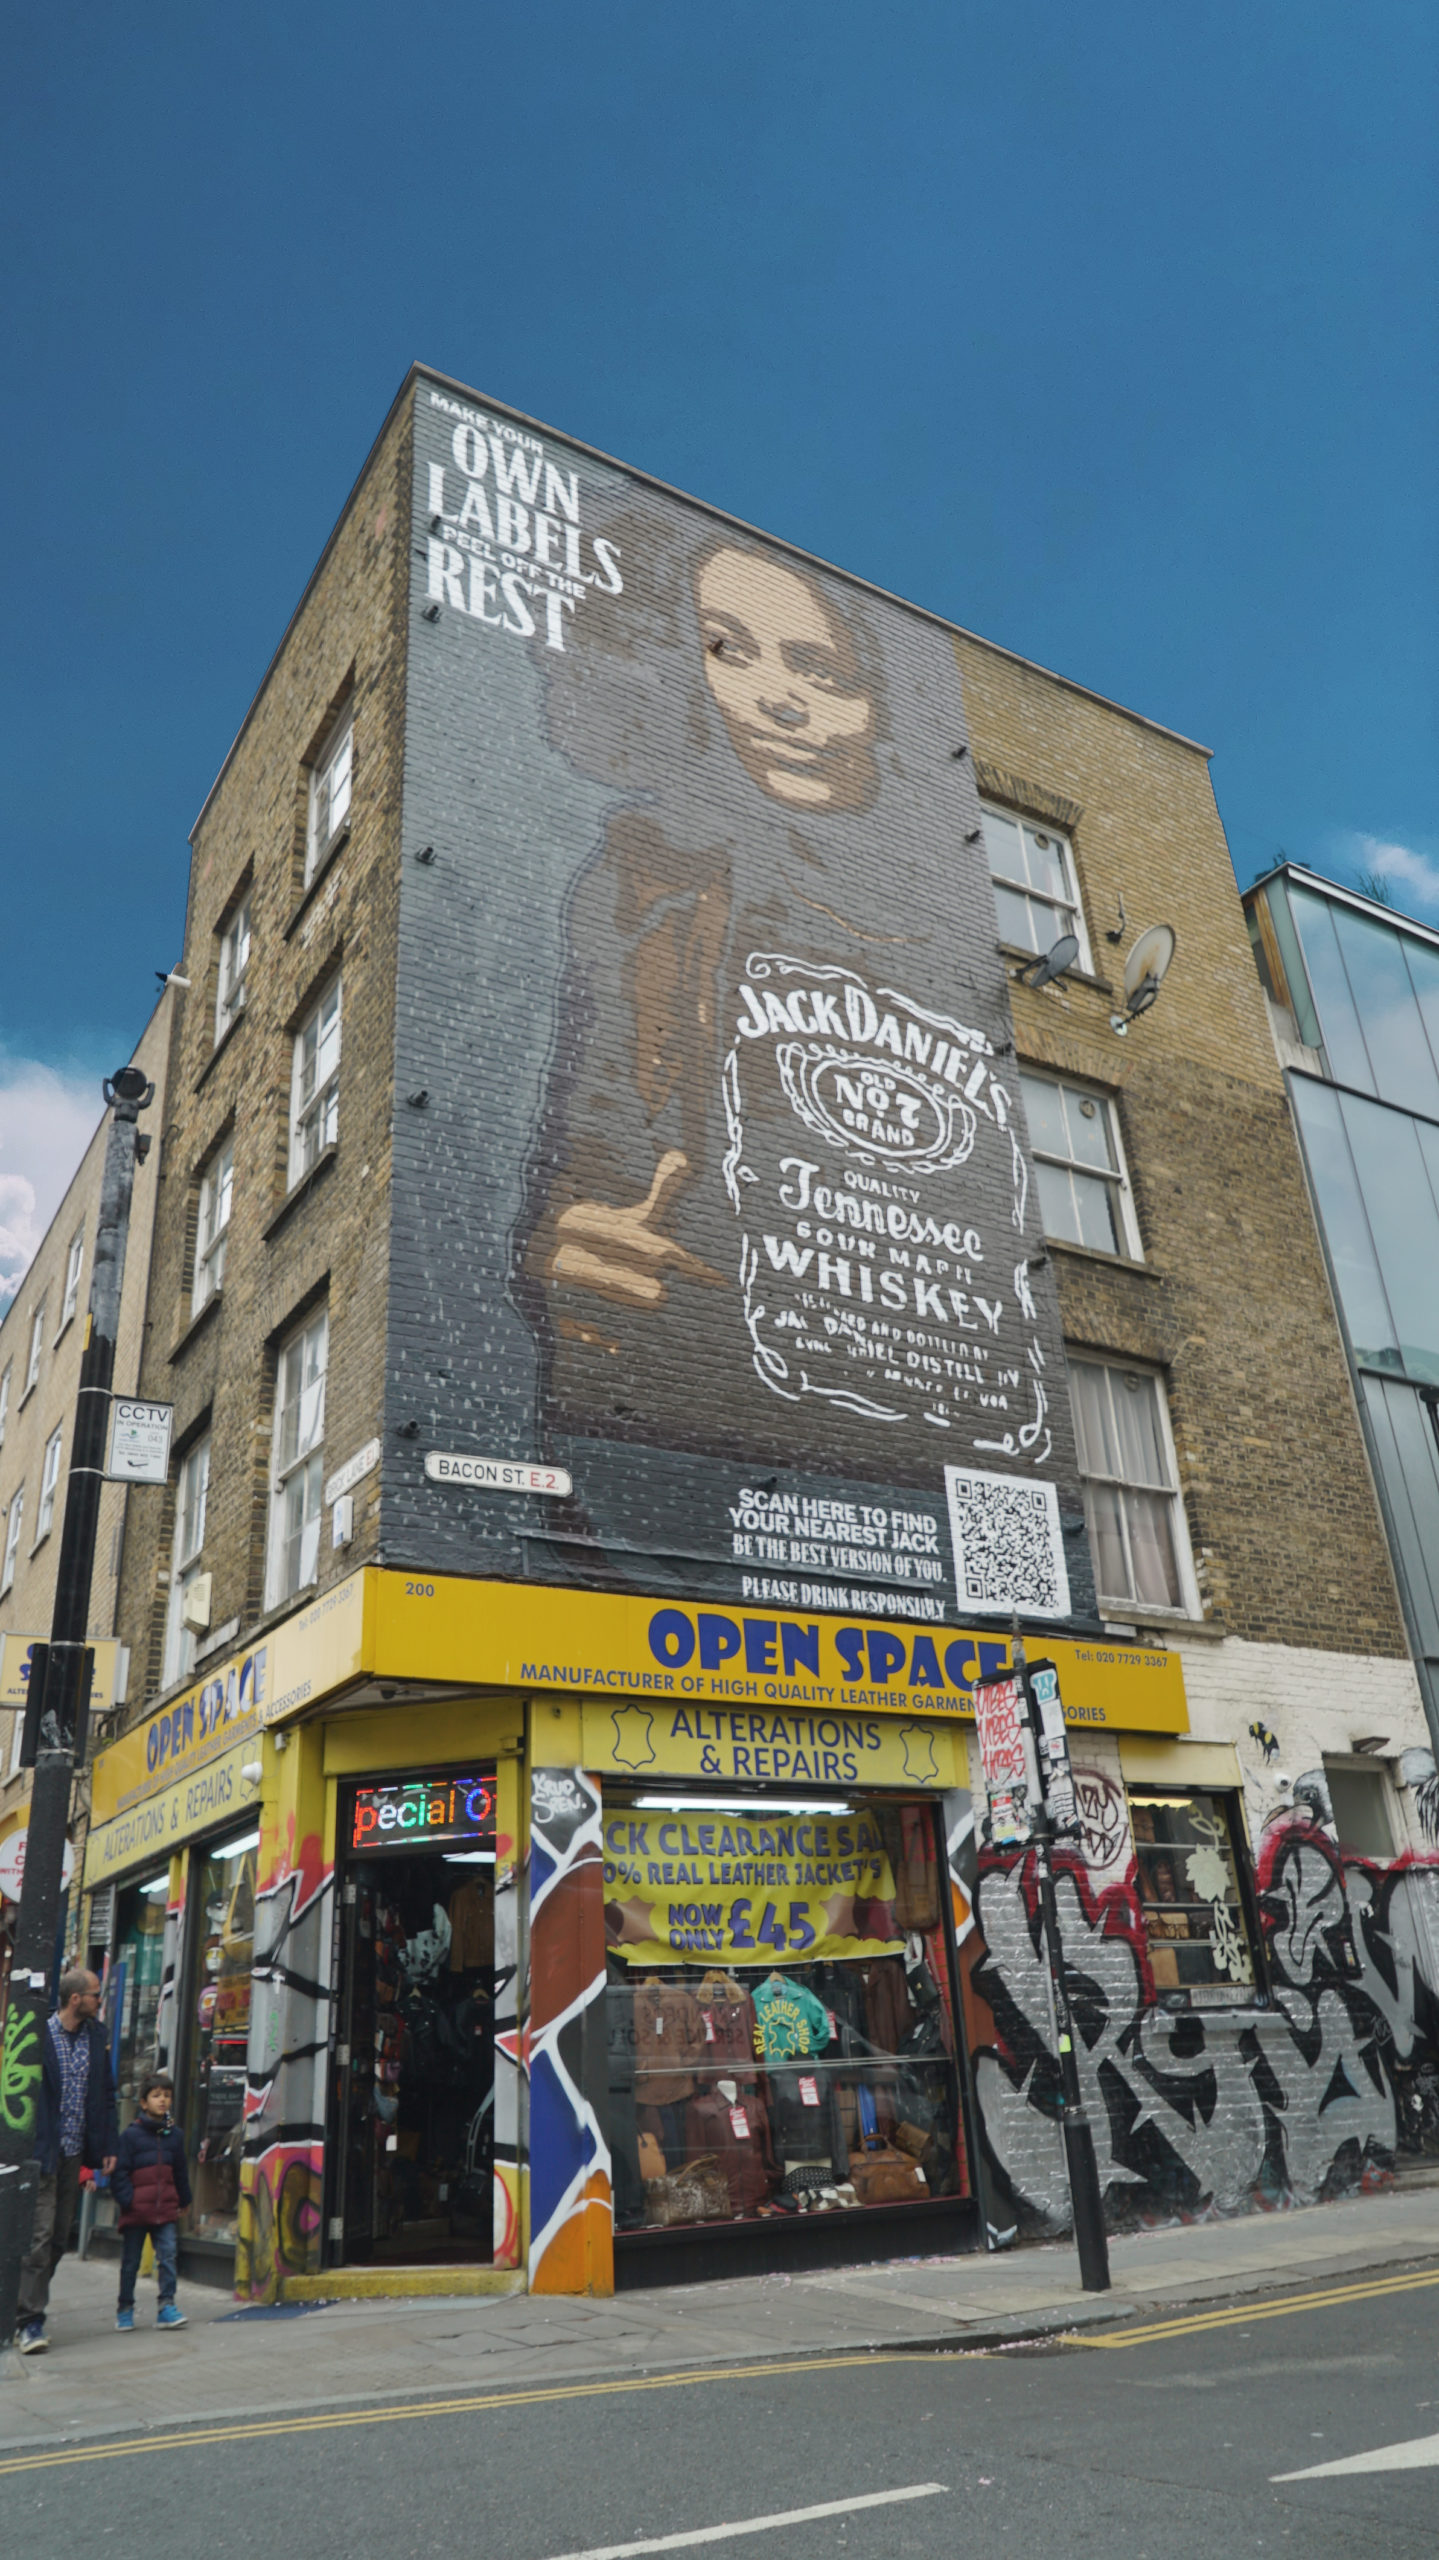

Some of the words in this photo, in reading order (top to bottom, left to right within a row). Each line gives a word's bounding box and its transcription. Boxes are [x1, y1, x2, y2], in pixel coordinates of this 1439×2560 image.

[430, 392, 489, 429] MAKE
[490, 420, 544, 457] YOUR
[452, 422, 582, 526] OWN
[427, 461, 624, 595] LABELS
[442, 525, 497, 561] PEEL
[501, 552, 542, 580] OFF
[544, 569, 587, 600] THE
[425, 536, 576, 652] REST
[737, 984, 849, 1042] JACK
[845, 984, 1013, 1132] DANIEL'S
[860, 1071, 897, 1091] OLD
[843, 1109, 915, 1147] BRAND
[896, 1093, 922, 1130] 7
[843, 1170, 921, 1204] QUALITY
[778, 1157, 985, 1263] Tennessee
[762, 1234, 1003, 1336] WHISKEY
[119, 1405, 168, 1423] CCTV
[439, 1459, 497, 1481] BACON
[503, 1467, 525, 1486] ST.
[530, 1471, 560, 1490] E.2.
[729, 1507, 790, 1535] YOUR
[794, 1516, 888, 1548] NEAREST
[891, 1529, 940, 1555] JACK
[738, 1488, 799, 1515] SCAN
[802, 1497, 858, 1523] HERE
[859, 1505, 888, 1528] TO
[891, 1510, 938, 1534] FIND
[732, 1533, 754, 1556] BE
[755, 1536, 788, 1561] THE
[790, 1541, 829, 1566] BEST
[829, 1547, 892, 1575] VERSION
[894, 1557, 913, 1578] OF
[912, 1559, 948, 1583] YOU.
[405, 1582, 435, 1598] 200
[742, 1575, 799, 1603] PLEASE
[800, 1583, 850, 1609] DRINK
[648, 1608, 821, 1679] OPEN
[1074, 1649, 1094, 1662] Tel:
[1096, 1653, 1115, 1665] 020
[1118, 1654, 1141, 1666] 7729
[1144, 1656, 1168, 1668] 3367
[520, 1663, 675, 1691] MANUFACTURER
[681, 1676, 704, 1693] OF
[711, 1679, 757, 1697] HIGH
[764, 1683, 835, 1702] QUALITY
[841, 1688, 908, 1708] LEATHER
[912, 1694, 977, 1713] GARMEN
[147, 1696, 196, 1773] OPEN
[199, 1645, 267, 1741] SPACE
[670, 1708, 882, 1751] ALTERATIONS
[700, 1744, 721, 1775] &
[733, 1746, 858, 1781] REPAIRS
[103, 1802, 166, 1864] ALTERATIONS
[170, 1797, 179, 1831] &
[185, 1764, 234, 1823] REPAIRS
[658, 1823, 831, 1858] CLEARANCE
[647, 1862, 704, 1886] REAL
[709, 1862, 791, 1886] LEATHER
[794, 1857, 883, 1887] JACKET'S
[668, 1903, 723, 1927] NOW
[727, 1897, 817, 1953] £45
[669, 1928, 725, 1951] ONLY
[759, 1999, 801, 2023] LEATHER
[753, 2023, 768, 2055] REAL
[796, 2018, 811, 2055] SHOP
